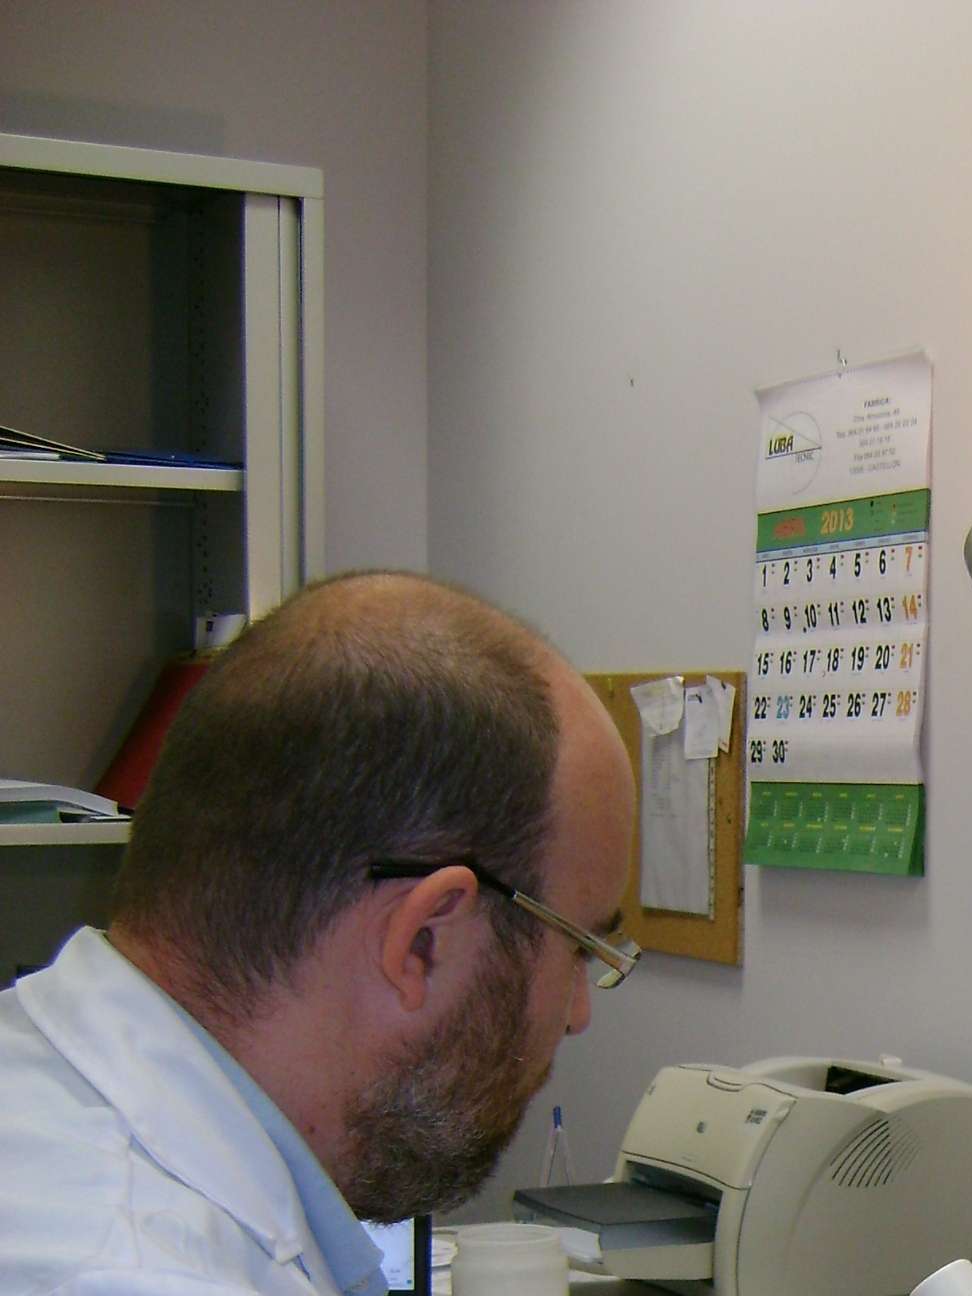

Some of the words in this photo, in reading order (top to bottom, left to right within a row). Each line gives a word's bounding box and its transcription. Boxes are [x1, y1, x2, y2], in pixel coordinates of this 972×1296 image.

[820, 508, 854, 535] 2013
[762, 564, 767, 587] 1
[784, 562, 790, 585] 2
[806, 559, 813, 582] 3
[830, 557, 836, 579] 4
[855, 553, 861, 577] 5
[879, 550, 886, 575] 6
[905, 547, 912, 572] 7
[762, 609, 769, 631] 8
[784, 607, 791, 630] 9
[805, 604, 817, 628] 10
[828, 602, 840, 626] 11
[852, 600, 867, 624] 12
[877, 597, 892, 622] 13
[902, 595, 918, 620] 14
[757, 653, 769, 675] 15
[779, 651, 792, 674] 16
[803, 650, 816, 672] 17
[827, 648, 839, 671] 18
[851, 646, 865, 670] 19
[875, 645, 890, 670] 20
[900, 643, 913, 668] 21
[755, 697, 767, 719] 22
[776, 696, 789, 719] 23
[800, 696, 812, 718] 24
[823, 695, 836, 717] 25
[847, 694, 861, 717] 26
[872, 692, 886, 717] 27
[896, 691, 911, 716] 28
[751, 741, 763, 763] 29
[773, 741, 785, 763] 30
